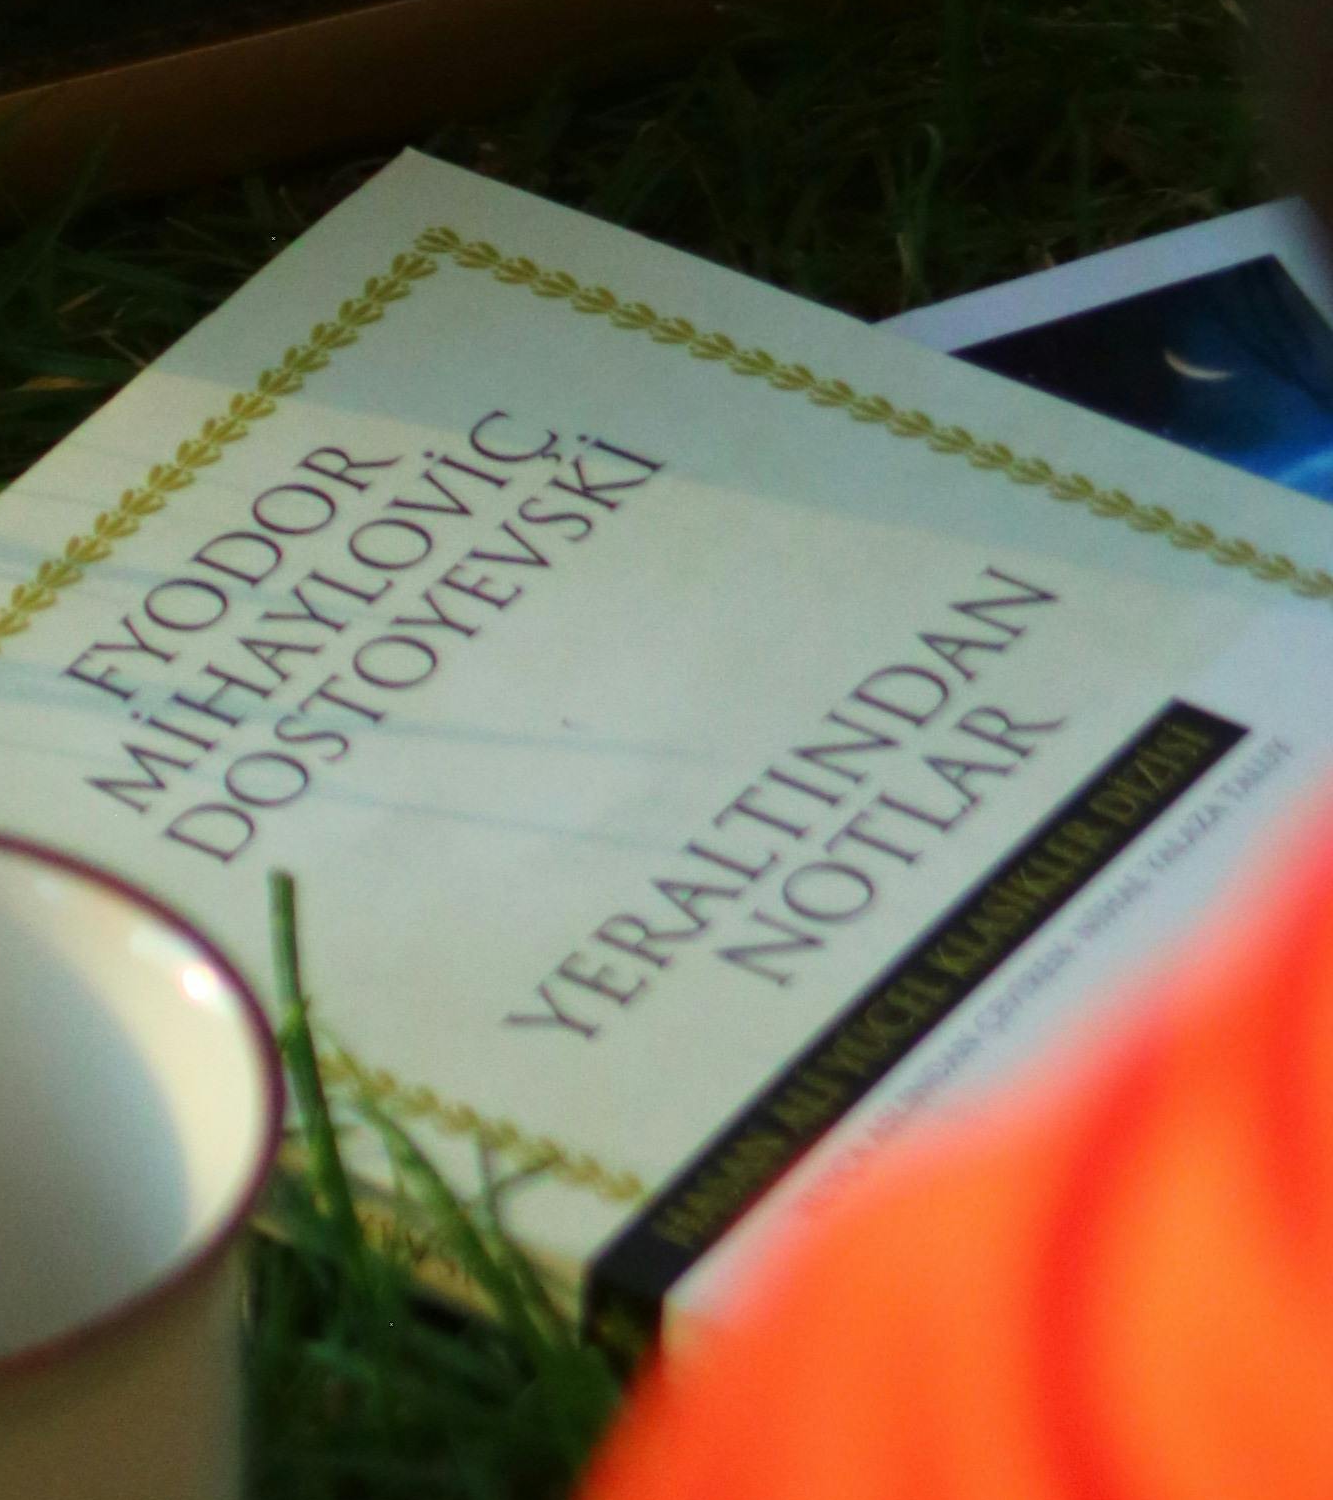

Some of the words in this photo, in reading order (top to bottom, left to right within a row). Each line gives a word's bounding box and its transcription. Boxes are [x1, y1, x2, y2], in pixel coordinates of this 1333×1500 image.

[60, 444, 405, 702] FYODOR
[83, 410, 562, 815] MİHAYLOVİÇ
[163, 433, 666, 864] DOSTOYEVSKİ
[503, 565, 1061, 1041] YERALTINDAN
[714, 705, 1072, 987] NOTLAR
